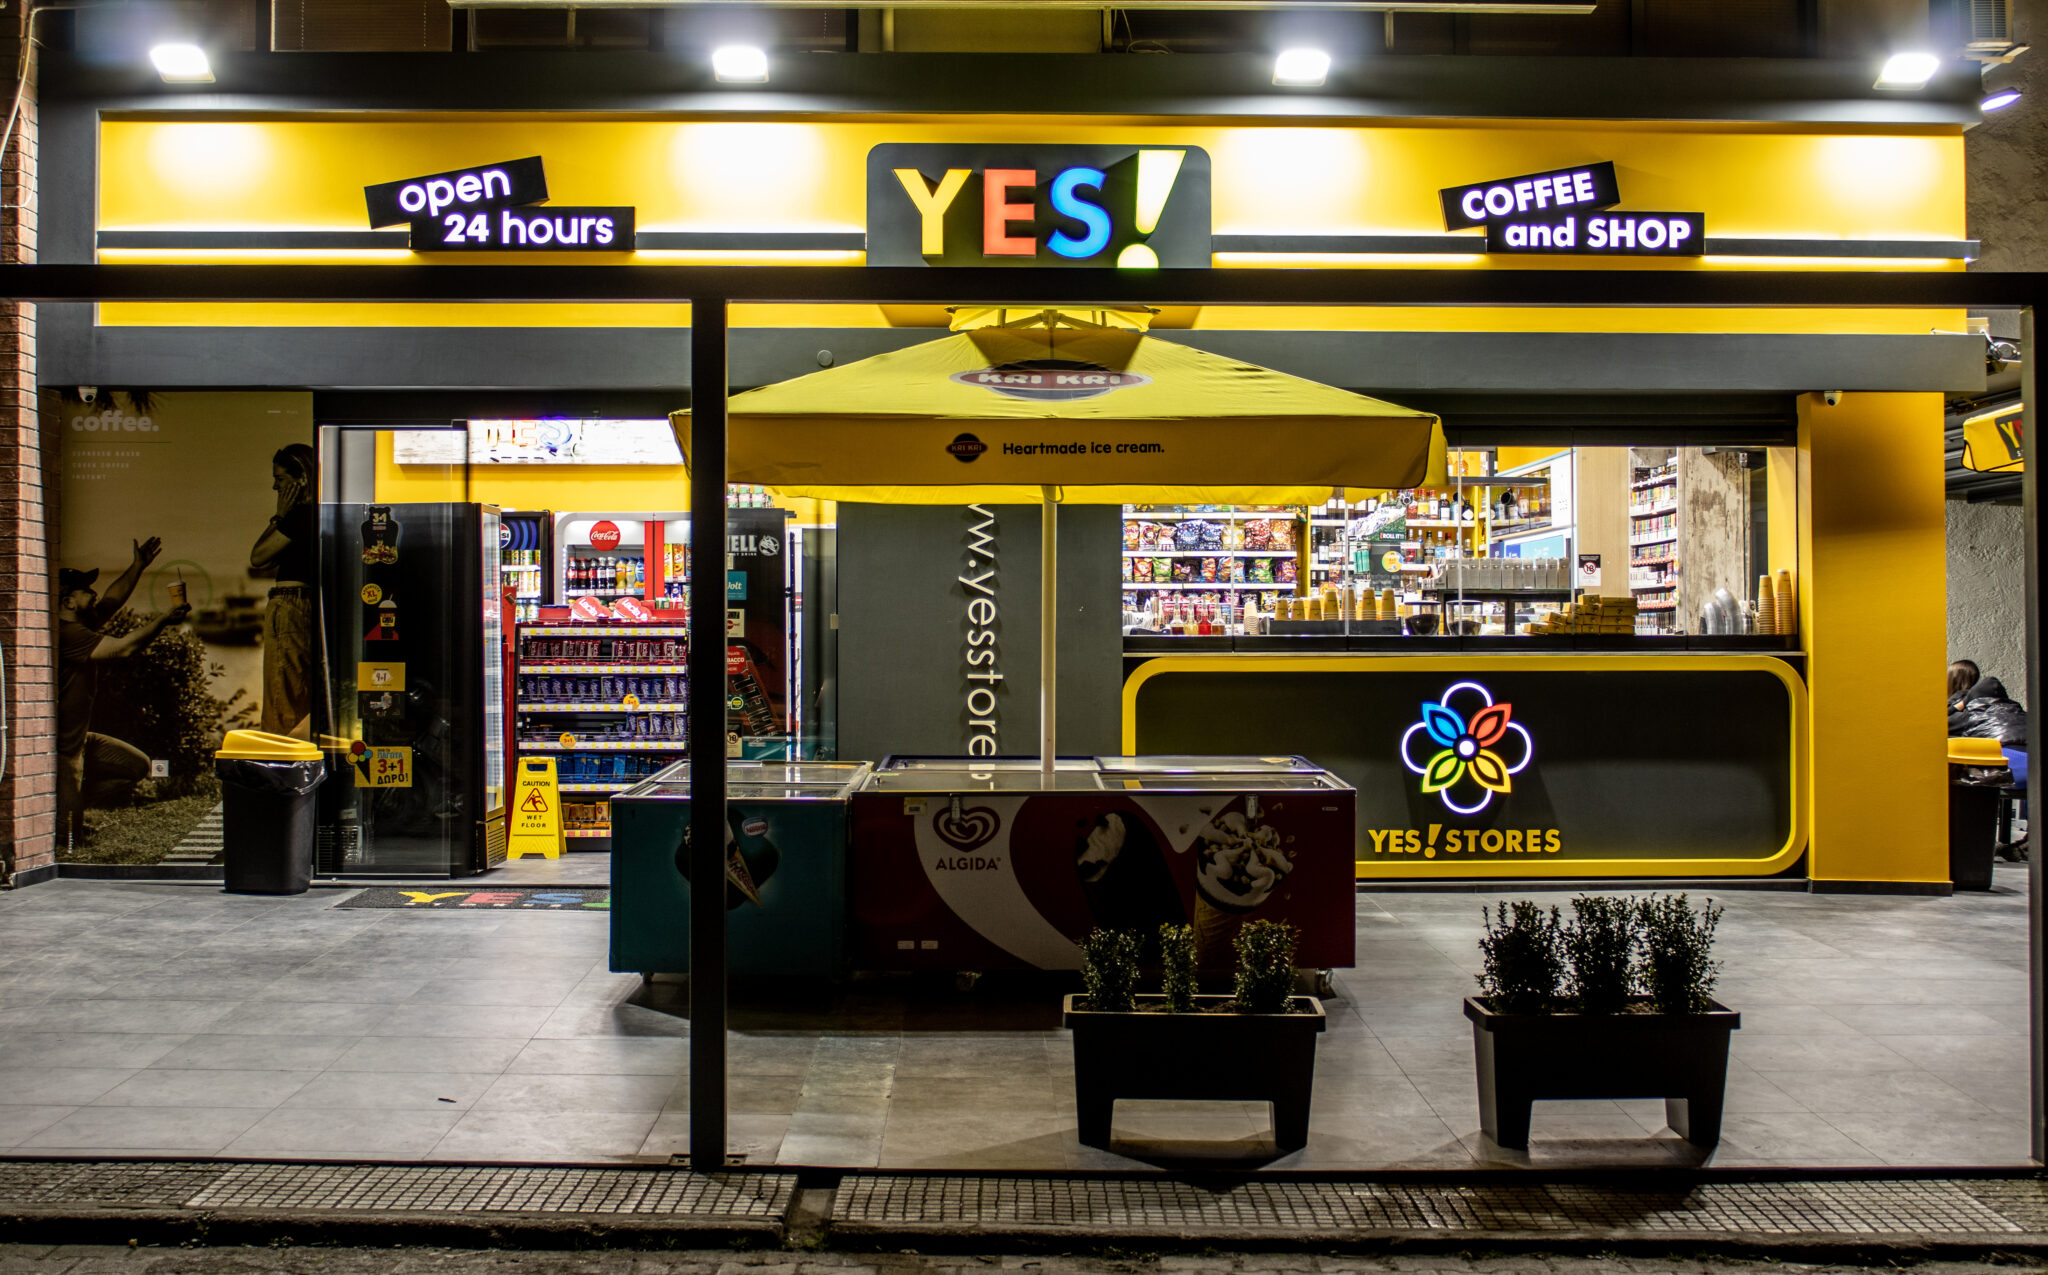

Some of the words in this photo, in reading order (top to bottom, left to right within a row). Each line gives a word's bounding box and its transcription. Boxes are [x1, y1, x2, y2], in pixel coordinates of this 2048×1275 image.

[398, 168, 512, 217] open
[1461, 171, 1595, 220] COFFEE
[892, 149, 1187, 268] YES!
[443, 213, 490, 243] 24
[502, 209, 615, 244] hours
[1504, 216, 1577, 247] and
[1586, 217, 1691, 249] SHOP
[978, 373, 1043, 385] KRI
[1056, 374, 1122, 385] KRI
[71, 409, 160, 433] coffee.
[1003, 442, 1087, 455] Heartmade
[1090, 441, 1114, 454] ice
[1116, 442, 1165, 455] cream.
[377, 758, 404, 774] 3+1
[377, 772, 409, 785] ΔΩΡΟ!
[1367, 823, 1443, 859] YES!
[1445, 828, 1561, 853] STORES
[935, 857, 998, 870] ALGIDA
